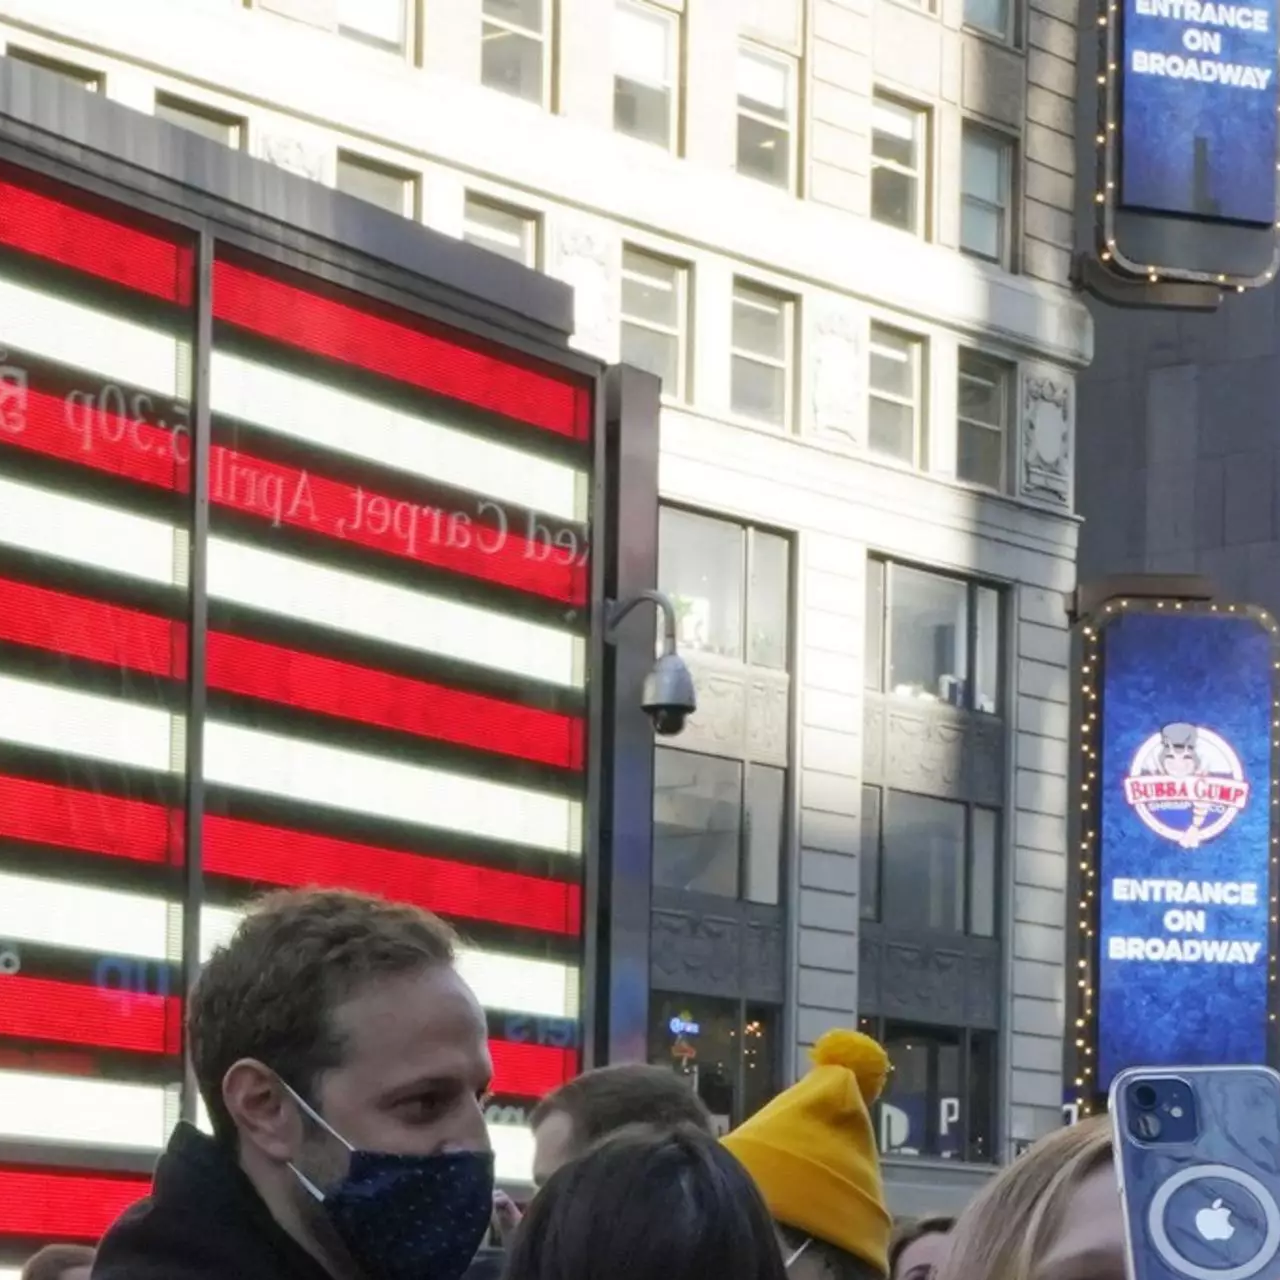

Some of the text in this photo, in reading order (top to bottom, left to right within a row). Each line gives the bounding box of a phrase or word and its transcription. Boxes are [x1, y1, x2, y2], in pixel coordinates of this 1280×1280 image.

[1135, 0, 1269, 32] ENTRANCE
[1182, 28, 1222, 54] ON
[1131, 50, 1272, 90] BROADWAY
[1130, 778, 1245, 803] BUBBA GUMP
[1112, 878, 1257, 907] ENTRANCE
[1163, 910, 1205, 934] ON
[1108, 937, 1261, 965] BROADWAY
